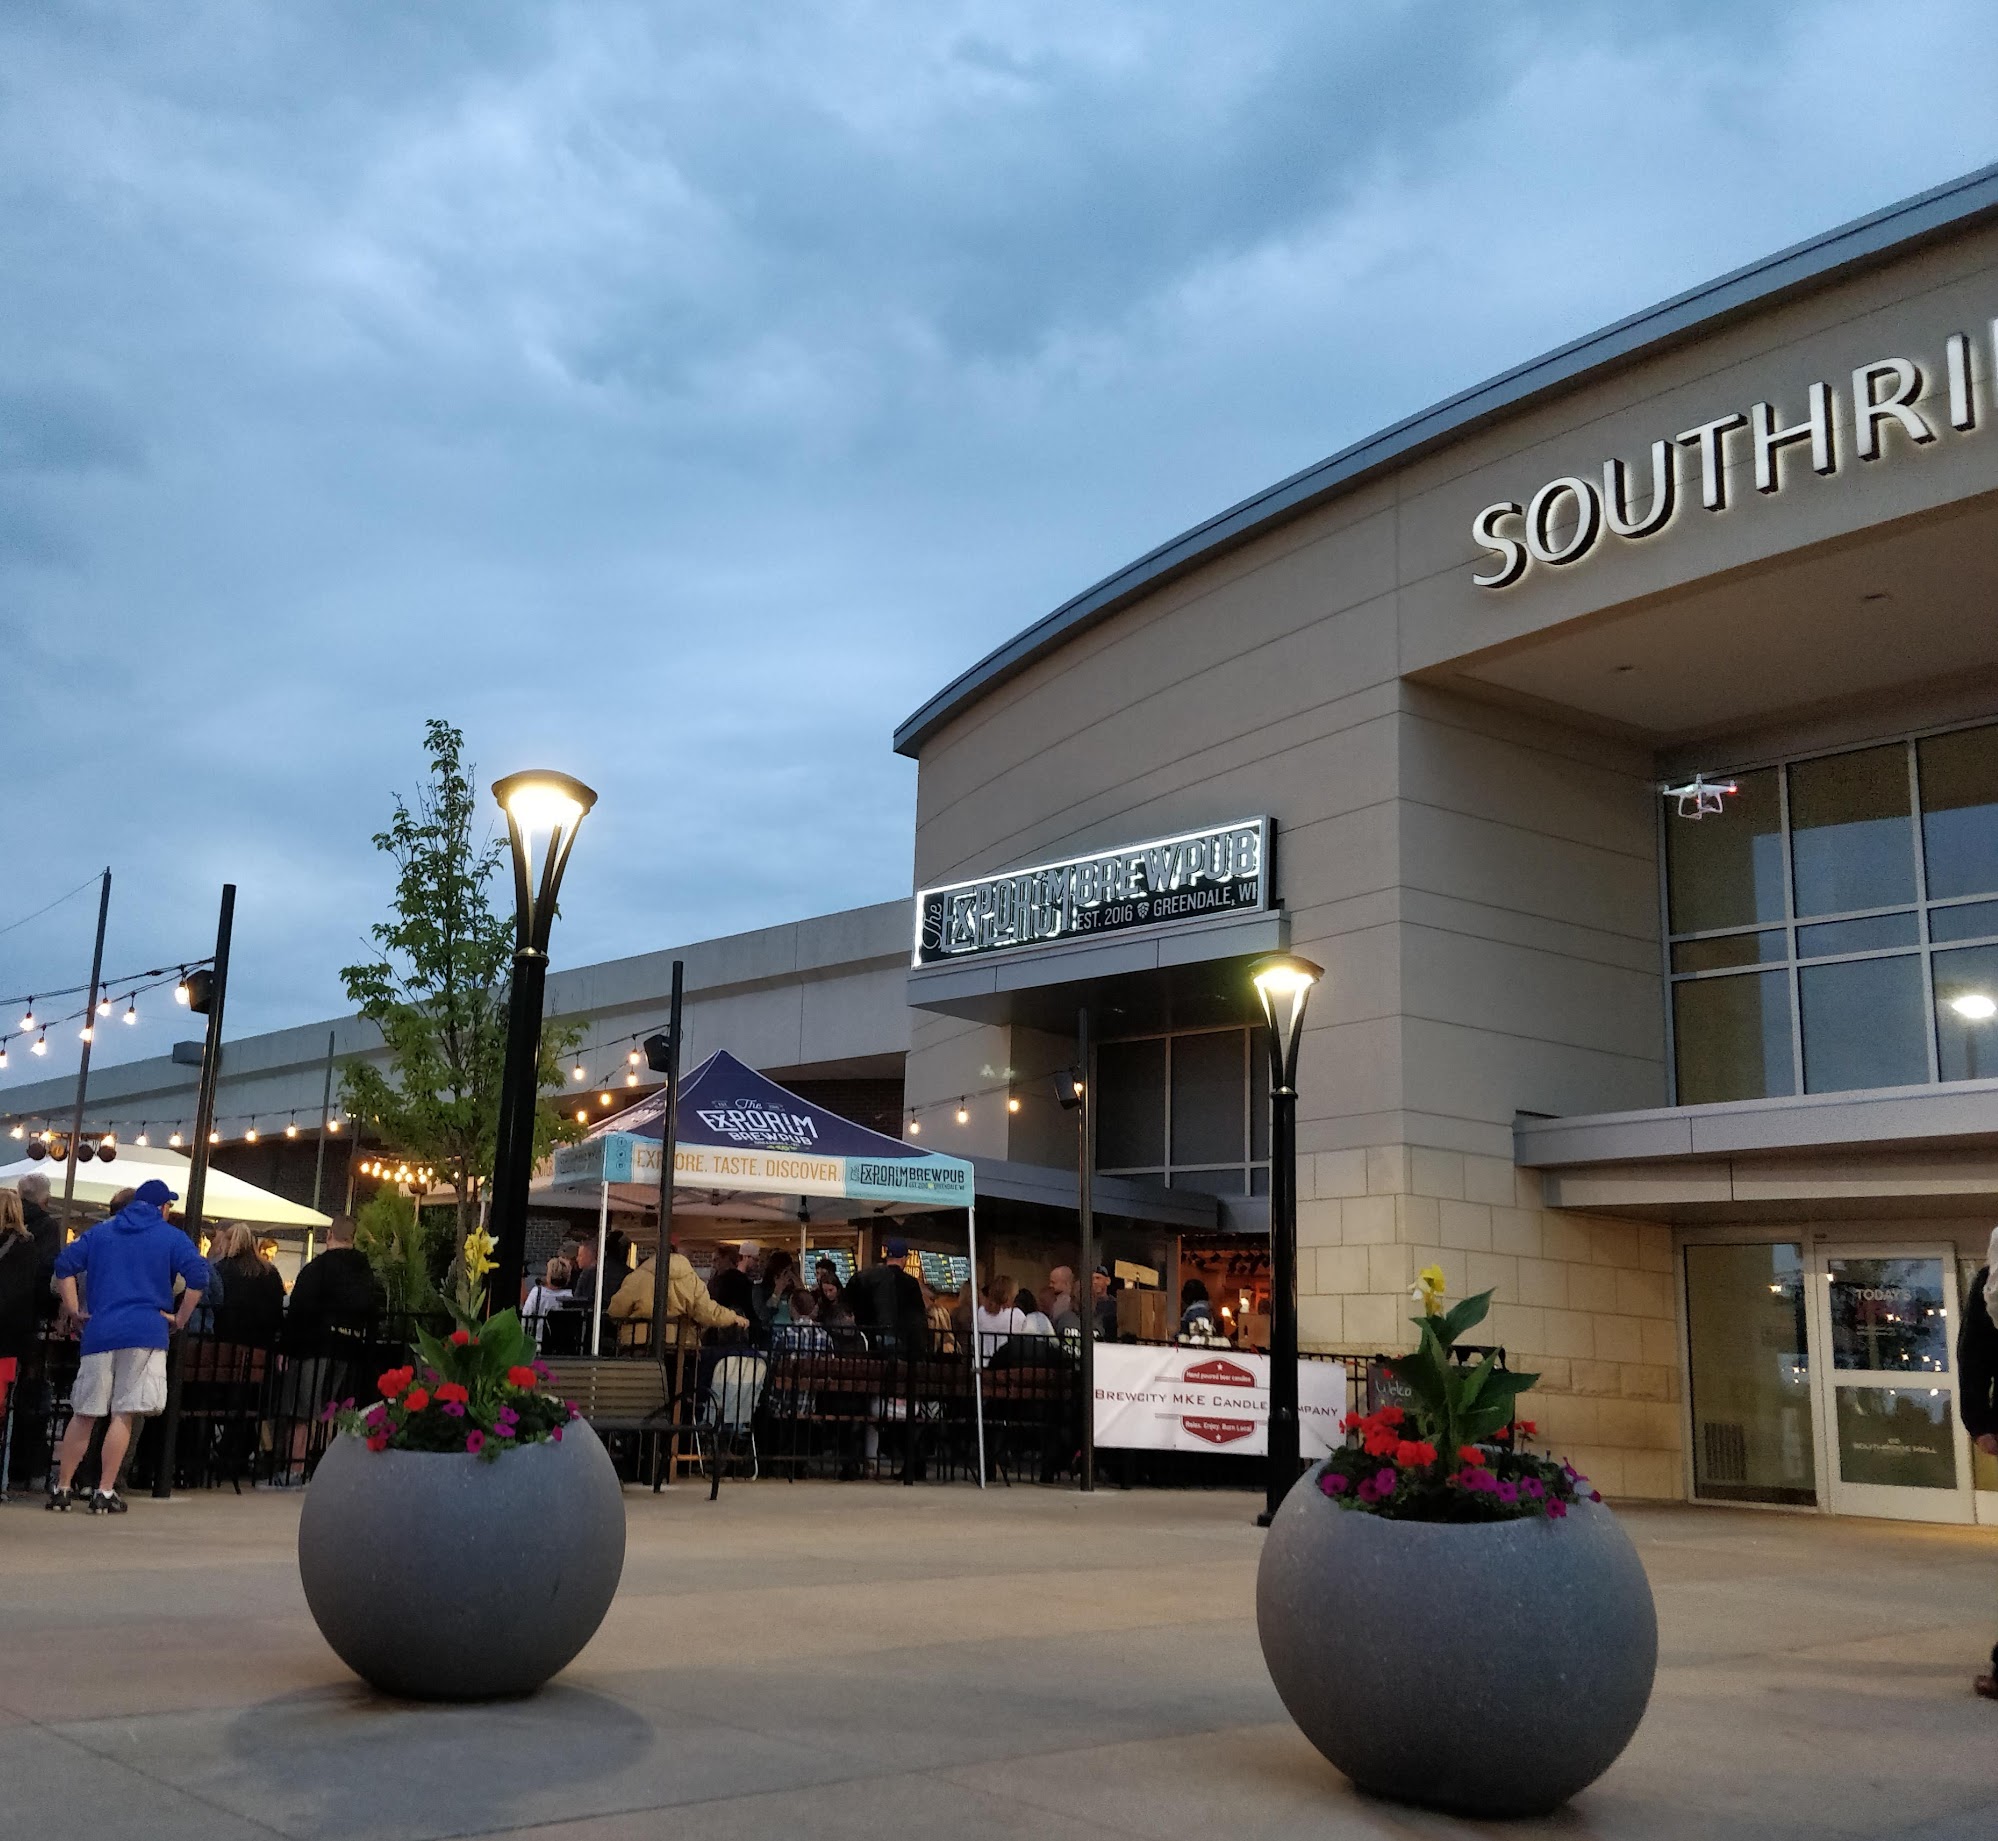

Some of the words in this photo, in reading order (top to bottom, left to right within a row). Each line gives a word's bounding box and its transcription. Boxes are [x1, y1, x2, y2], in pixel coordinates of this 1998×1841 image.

[1472, 317, 1998, 589] SOUTHRI
[1074, 829, 1257, 906] BREWPUB
[1077, 912, 1102, 930] EST.
[1105, 904, 1133, 926] 2016
[1153, 886, 1237, 917] GREENDALE,
[735, 1098, 763, 1109] The
[728, 1132, 813, 1146] BREWPUB
[713, 1156, 761, 1177] TASTE.
[766, 1159, 841, 1182] DISCOVER.
[909, 1167, 965, 1184] BREWPUB
[1173, 1393, 1205, 1406] MKE
[1297, 1405, 1338, 1416] MPANY
